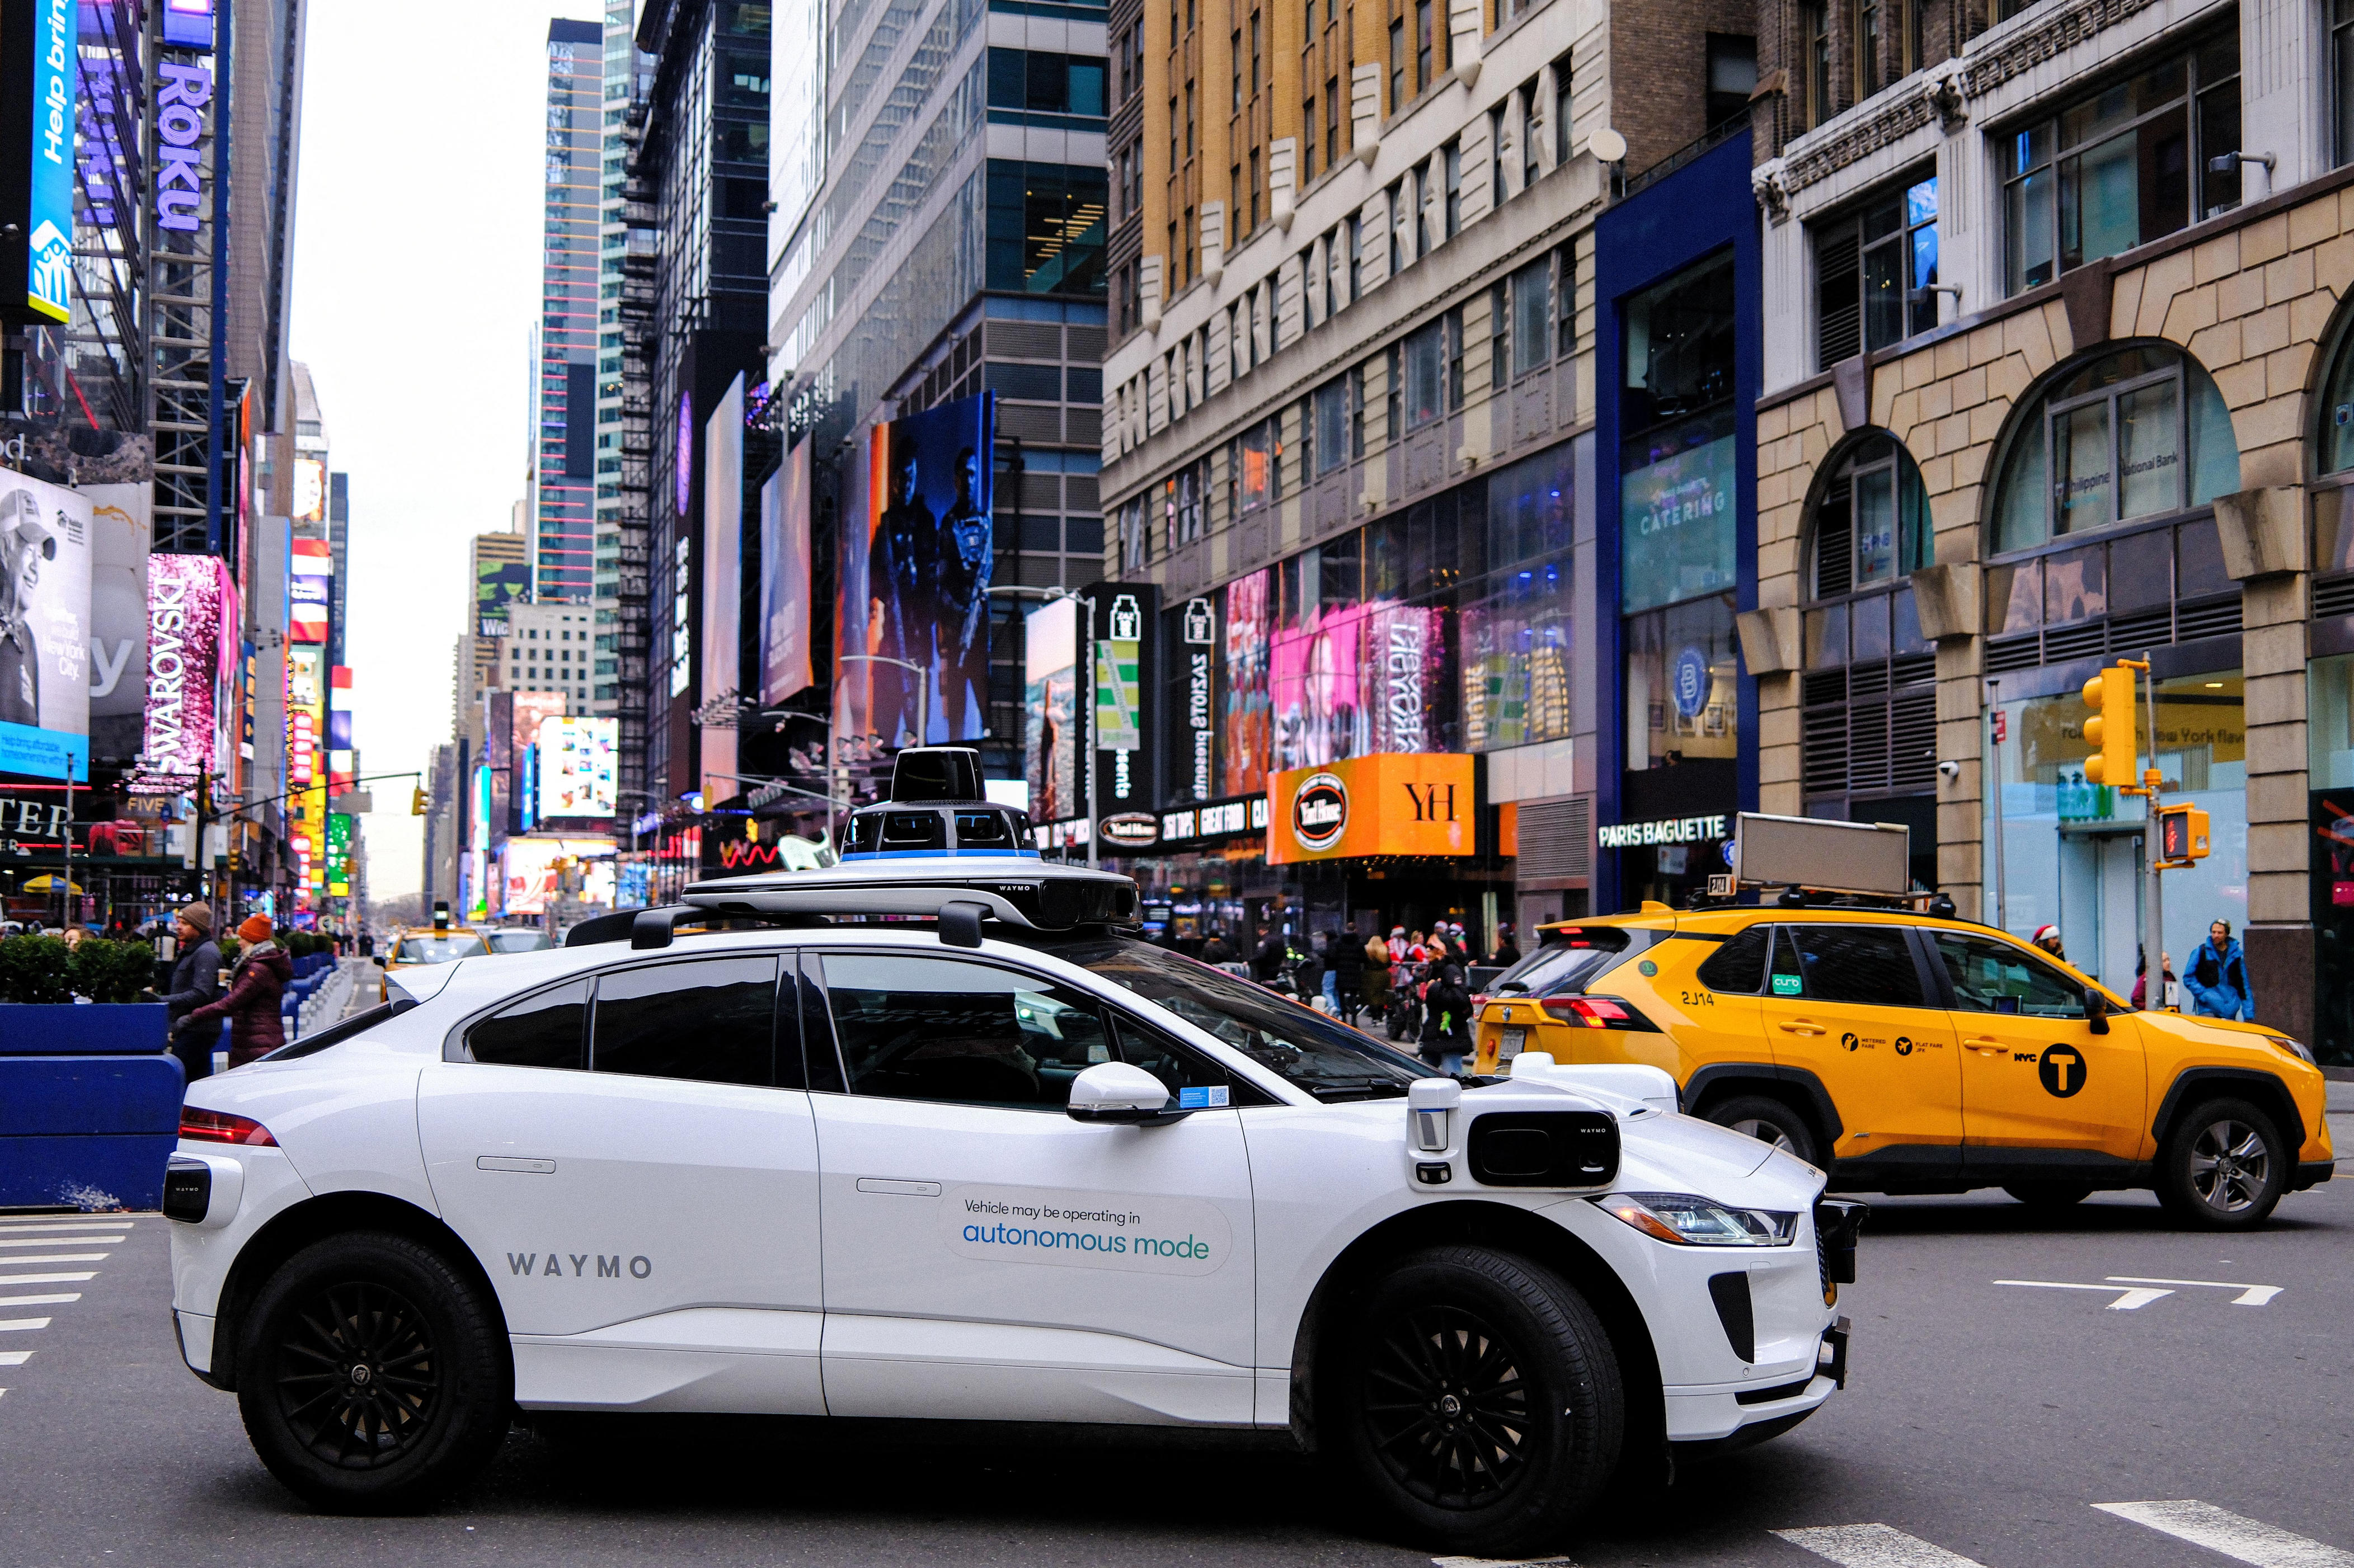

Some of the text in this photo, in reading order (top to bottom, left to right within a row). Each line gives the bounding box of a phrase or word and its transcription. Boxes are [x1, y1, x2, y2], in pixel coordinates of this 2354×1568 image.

[44, 0, 69, 164] Help brin
[2156, 451, 2178, 468] Bank
[1641, 492, 1725, 536] CATERING
[150, 577, 186, 775] SWAROVSKI
[127, 797, 166, 813] FIVE
[1403, 783, 1458, 822] YH
[1598, 814, 1727, 848] PARIS BAGUETTE
[1774, 977, 1799, 987] curb
[1681, 991, 1714, 1006] 2J14
[2014, 1053, 2037, 1063] NYC
[2049, 1054, 2076, 1091] T
[965, 1199, 1140, 1227] Vehicle may be operating in
[963, 1222, 1209, 1260] autonomous mode
[506, 1252, 652, 1279] WAYMO
